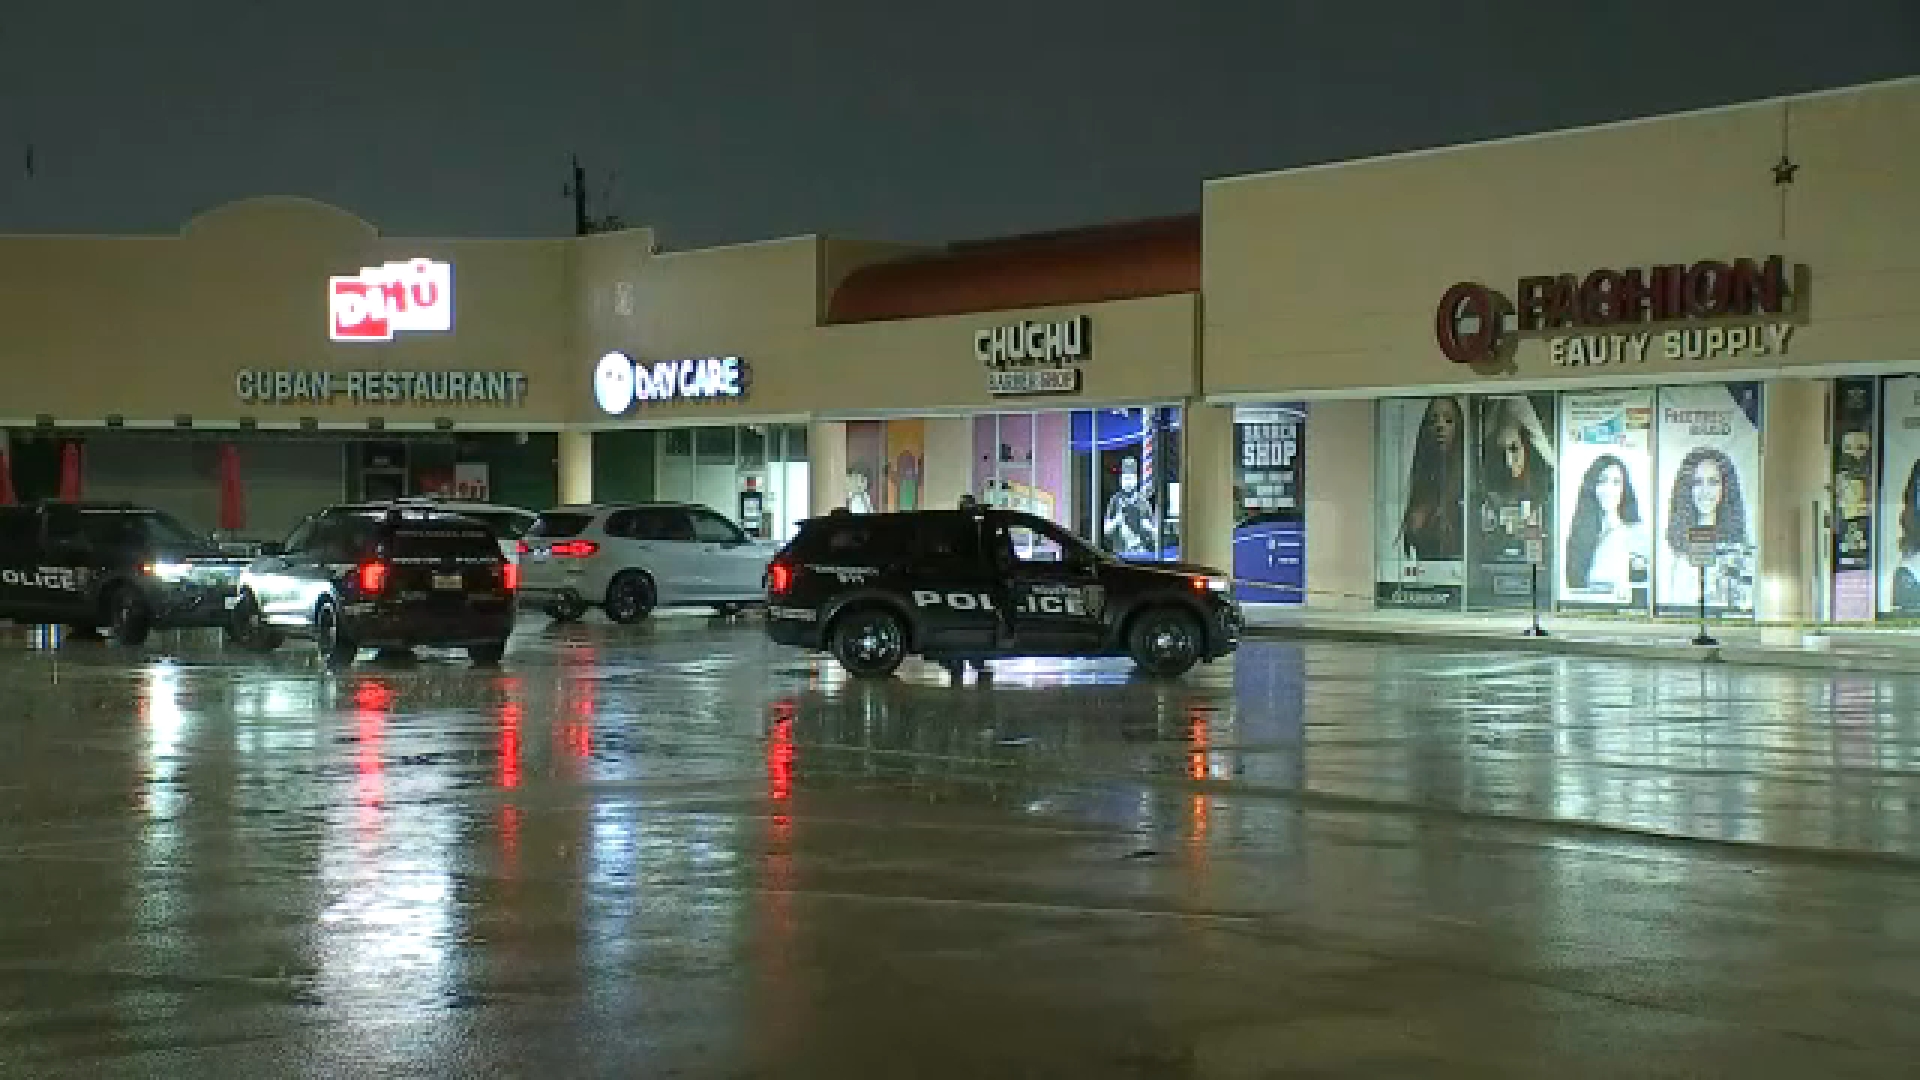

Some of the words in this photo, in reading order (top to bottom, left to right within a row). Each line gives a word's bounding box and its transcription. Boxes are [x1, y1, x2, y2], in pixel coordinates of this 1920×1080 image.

[1518, 255, 1786, 330] FASHION
[974, 315, 1082, 366] CHUCHU
[1550, 333, 1650, 366] EAUTY
[1664, 323, 1792, 359] SUPPLY
[237, 370, 330, 401] CUBAN
[347, 370, 526, 402] RESTAURANT
[636, 363, 677, 400] DAY
[680, 357, 740, 397] CARE
[1243, 441, 1297, 466] SHOP
